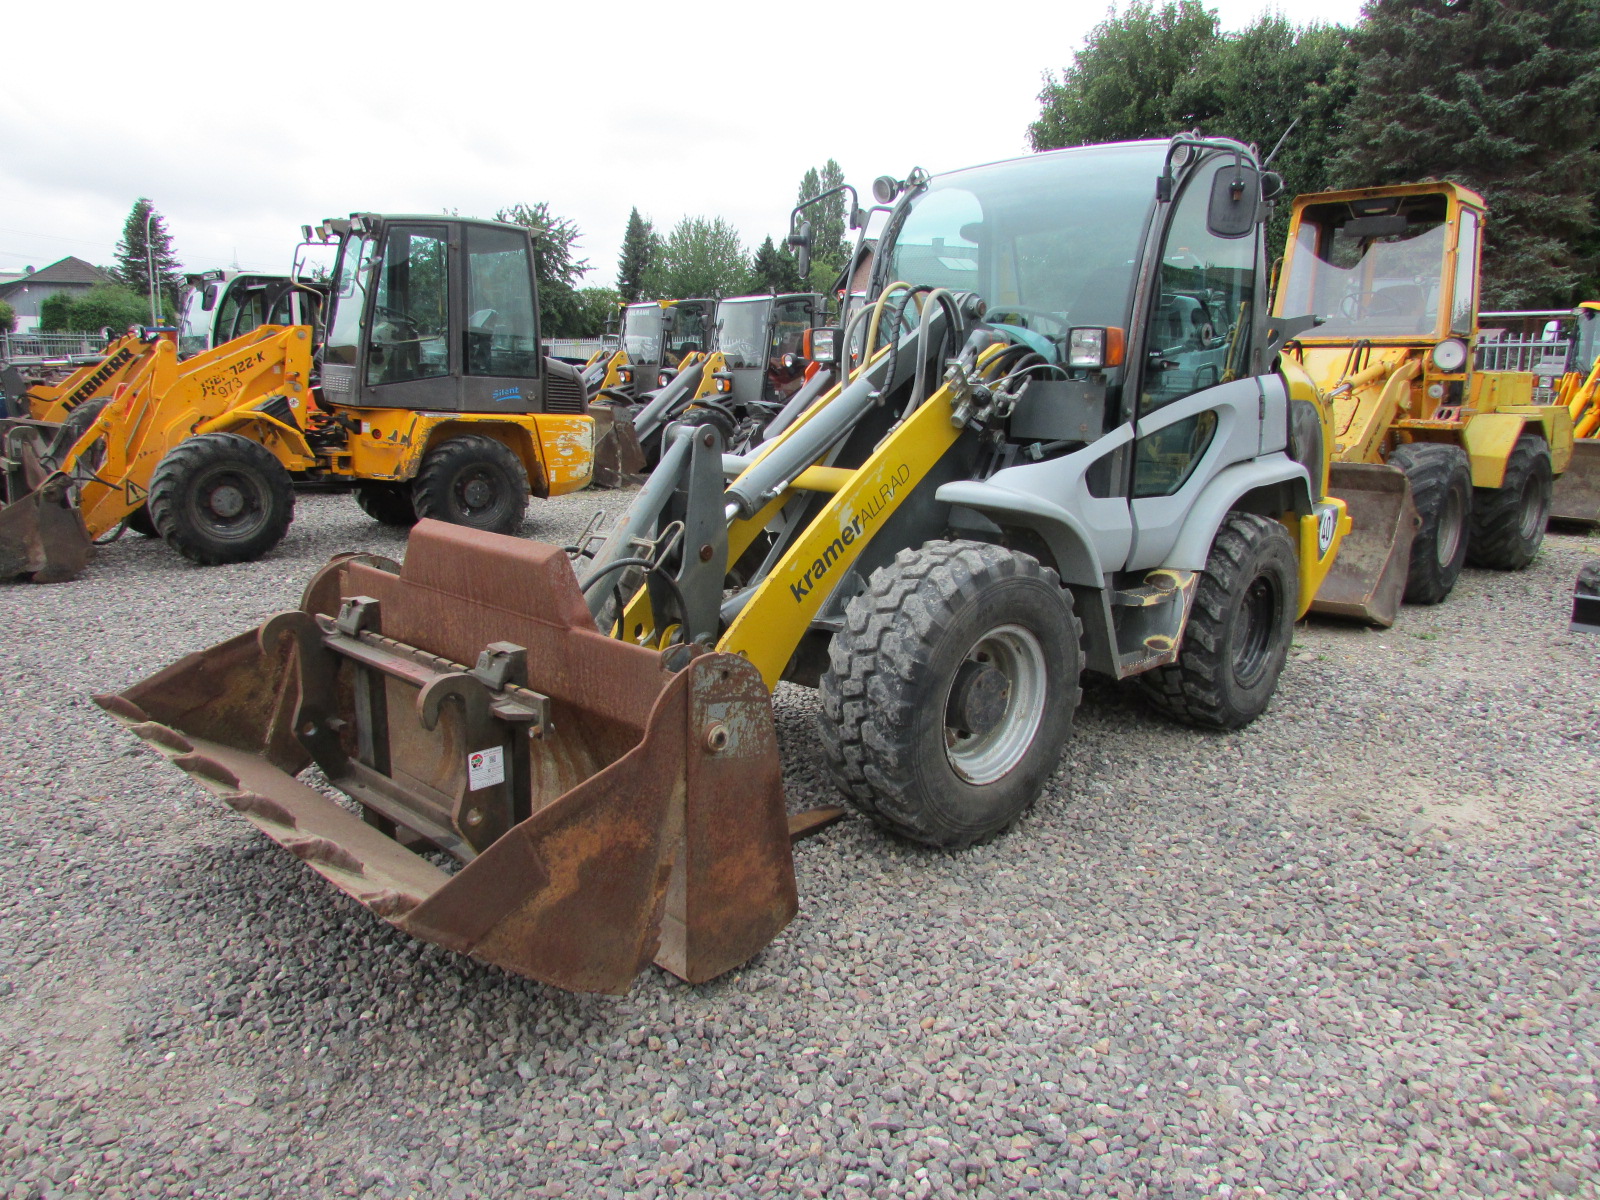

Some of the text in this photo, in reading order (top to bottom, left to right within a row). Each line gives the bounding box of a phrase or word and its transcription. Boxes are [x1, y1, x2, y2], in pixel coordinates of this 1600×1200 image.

[229, 350, 265, 375] 722-K
[61, 347, 135, 413] LIEBHERR
[218, 377, 243, 398] 973
[492, 386, 519, 399] Silent
[1321, 516, 1331, 542] 40
